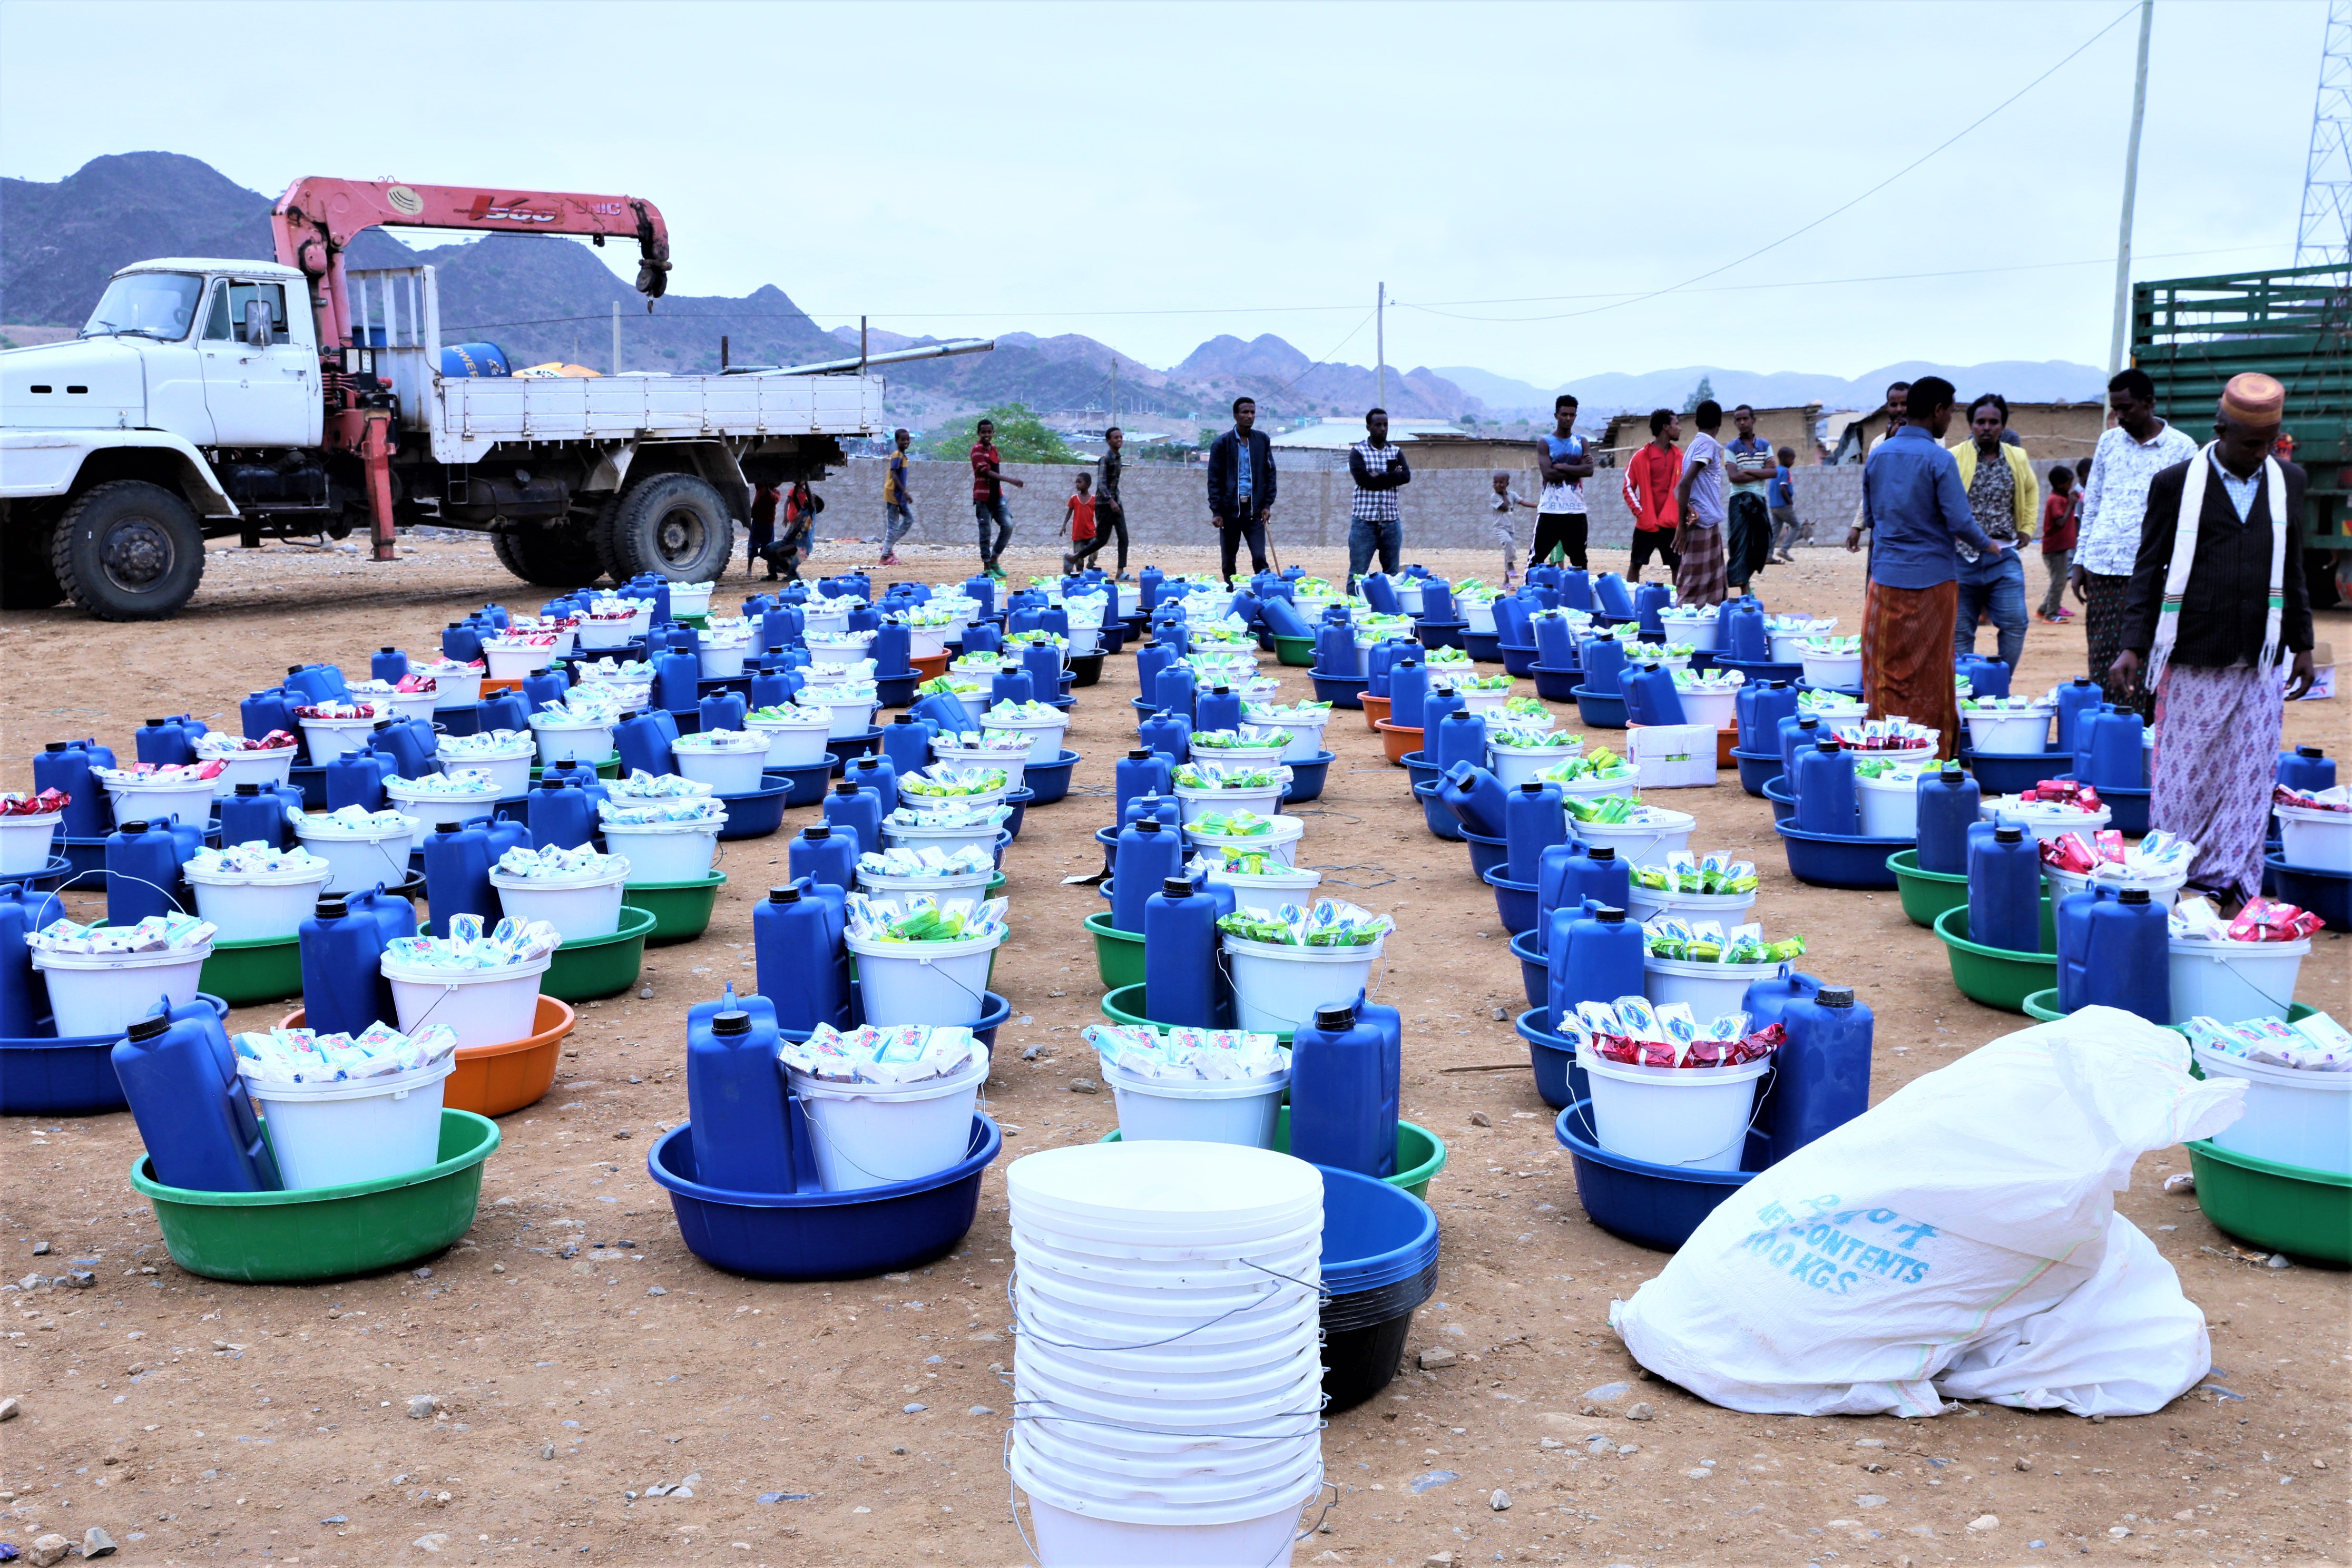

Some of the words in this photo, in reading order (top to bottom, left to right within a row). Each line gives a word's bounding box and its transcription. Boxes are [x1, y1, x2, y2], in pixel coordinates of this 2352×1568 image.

[452, 346, 479, 377] OWER
[1741, 1230, 1796, 1268] 100
[1789, 1251, 1858, 1295] KGS
[1790, 1223, 1929, 1284] CONTENTS
